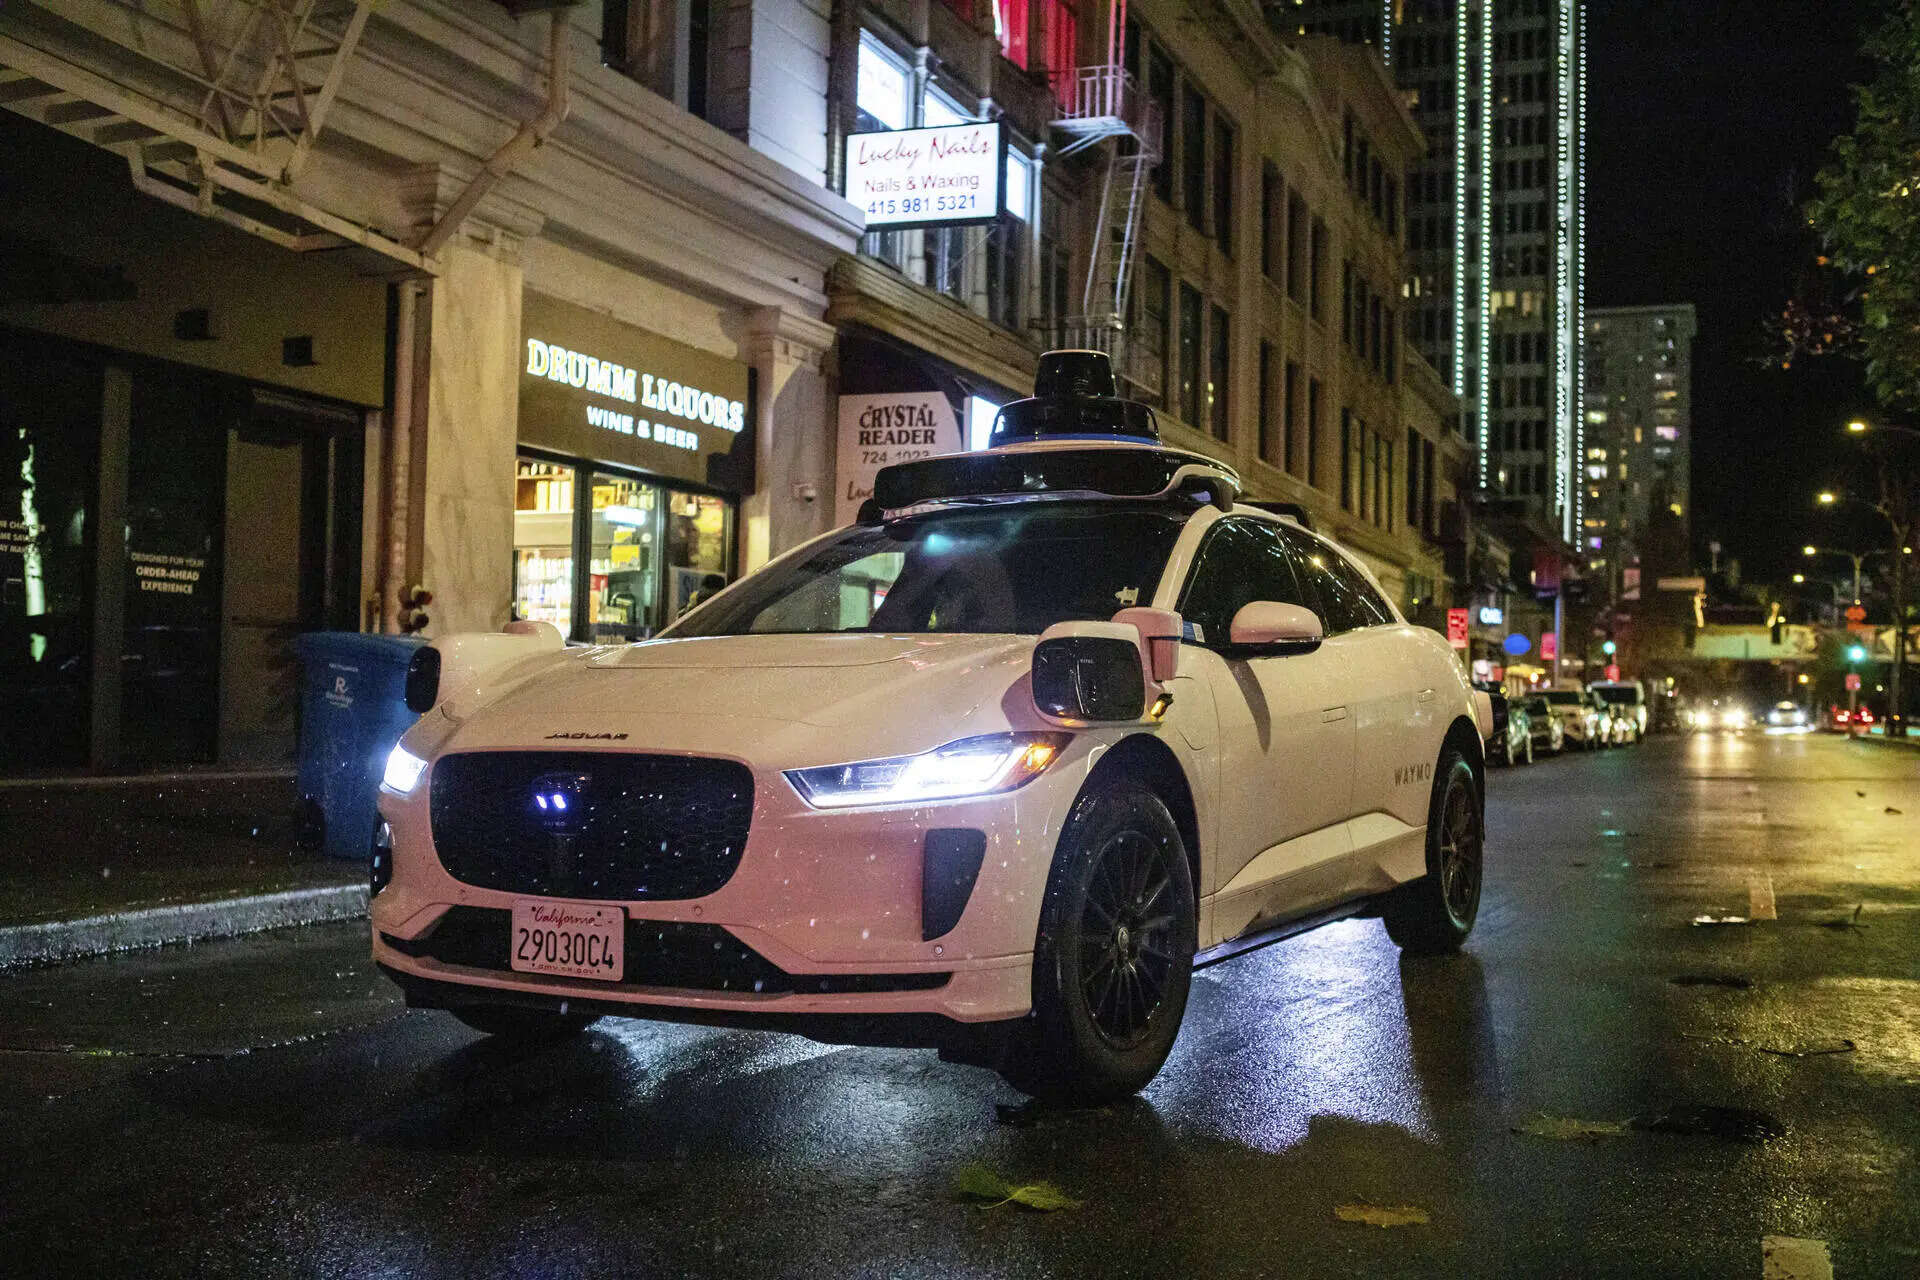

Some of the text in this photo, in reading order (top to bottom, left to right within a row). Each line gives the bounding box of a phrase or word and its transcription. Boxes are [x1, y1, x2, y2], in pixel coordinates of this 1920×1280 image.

[858, 130, 991, 169] Lucky Nails
[865, 174, 980, 193] Nails & Waxing
[868, 194, 976, 215] 415 981 5321
[527, 338, 745, 433] DRUMM LIQUORS
[859, 403, 937, 429] CRYSTAL
[586, 405, 699, 451] WINE & BEER
[859, 429, 936, 446] READER
[136, 566, 200, 581] ORDER-AHEAD
[141, 580, 193, 594] EXPERIENCE
[1394, 763, 1431, 787] WAYMO
[534, 906, 602, 928] California
[517, 928, 615, 969] 29030C4
